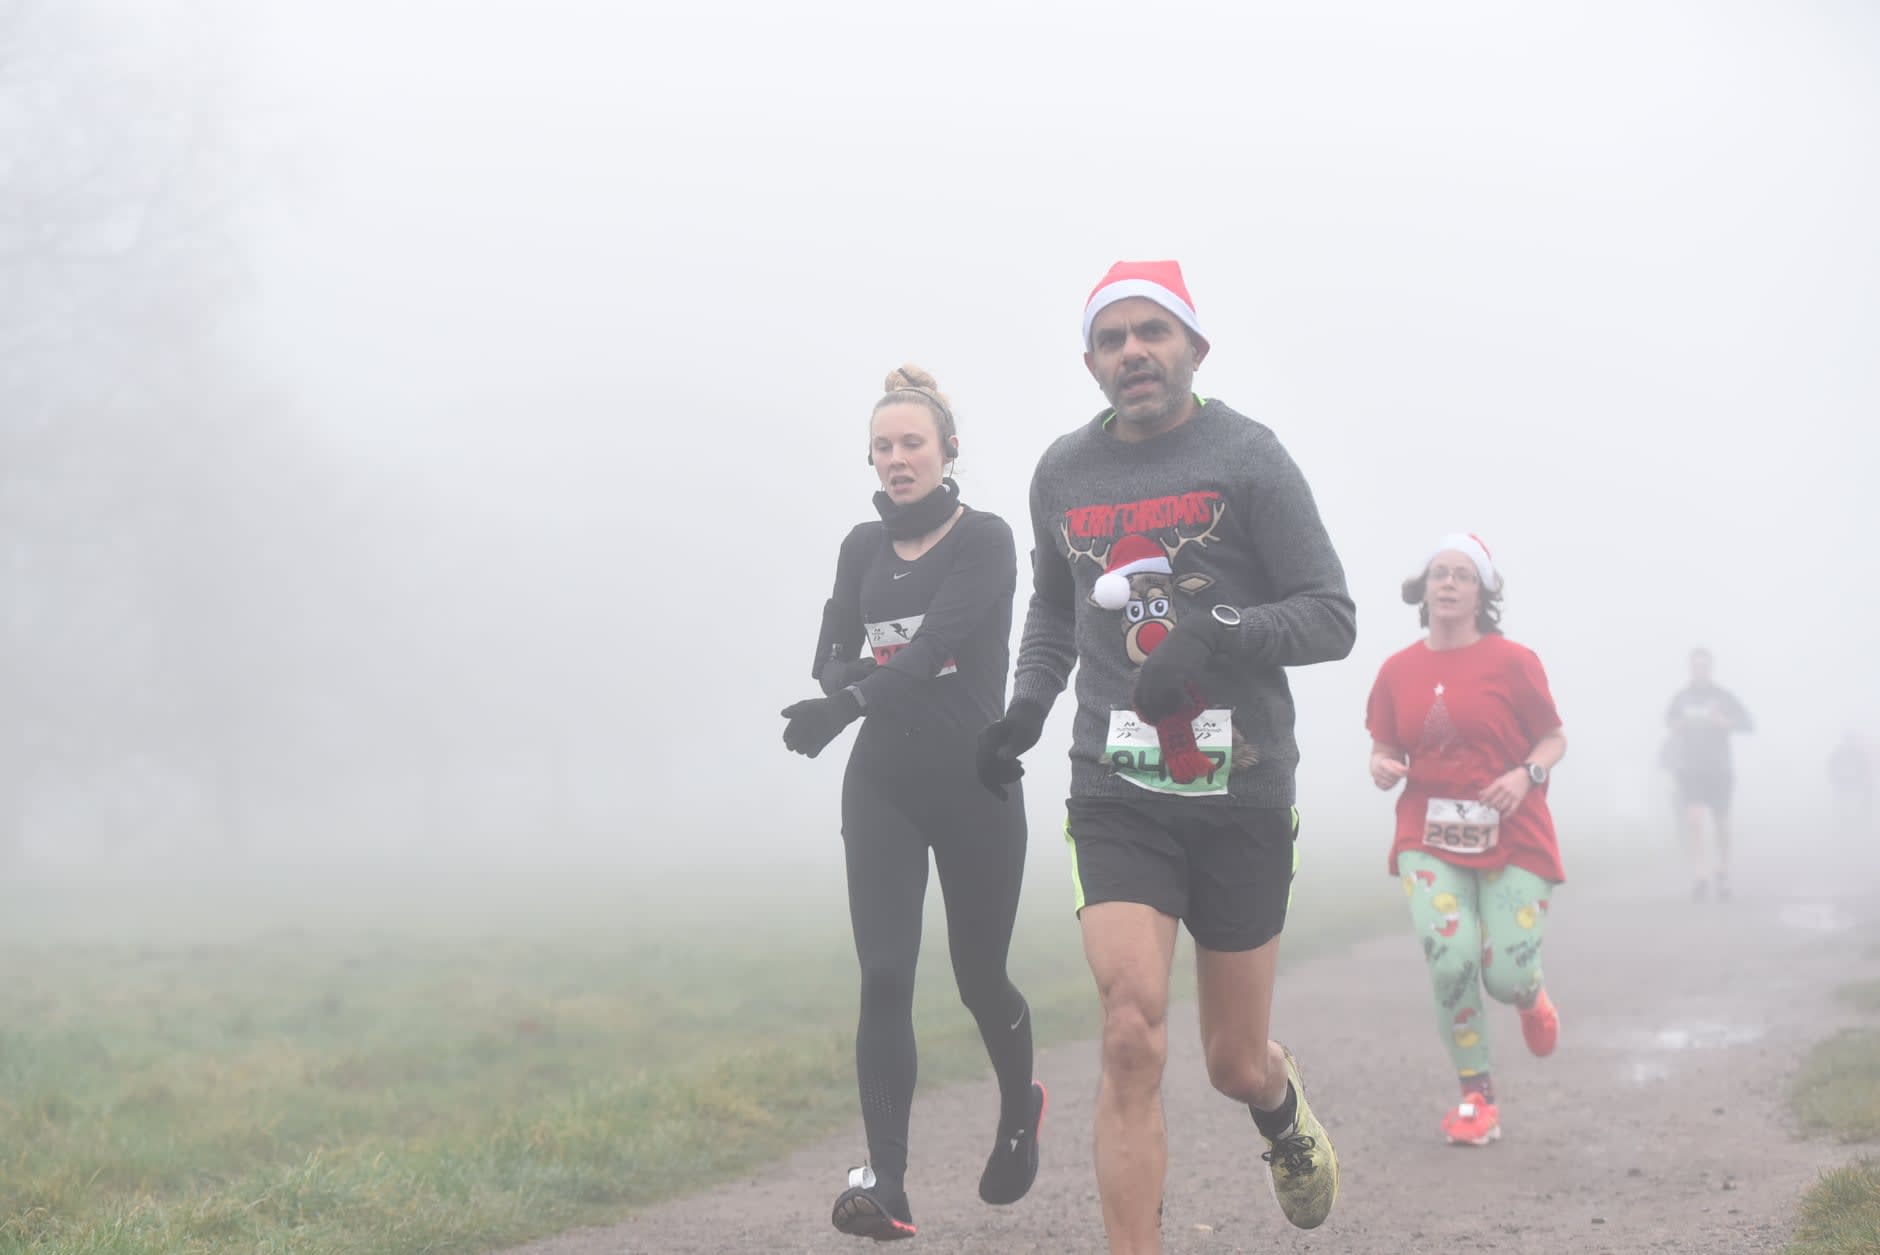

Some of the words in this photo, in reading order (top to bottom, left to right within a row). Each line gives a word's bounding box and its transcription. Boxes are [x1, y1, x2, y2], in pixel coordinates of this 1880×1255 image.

[1065, 504, 1117, 537] MERRY
[1114, 491, 1220, 533] CHRISTMAS
[1111, 750, 1226, 784] 947
[1426, 822, 1494, 848] 2651
